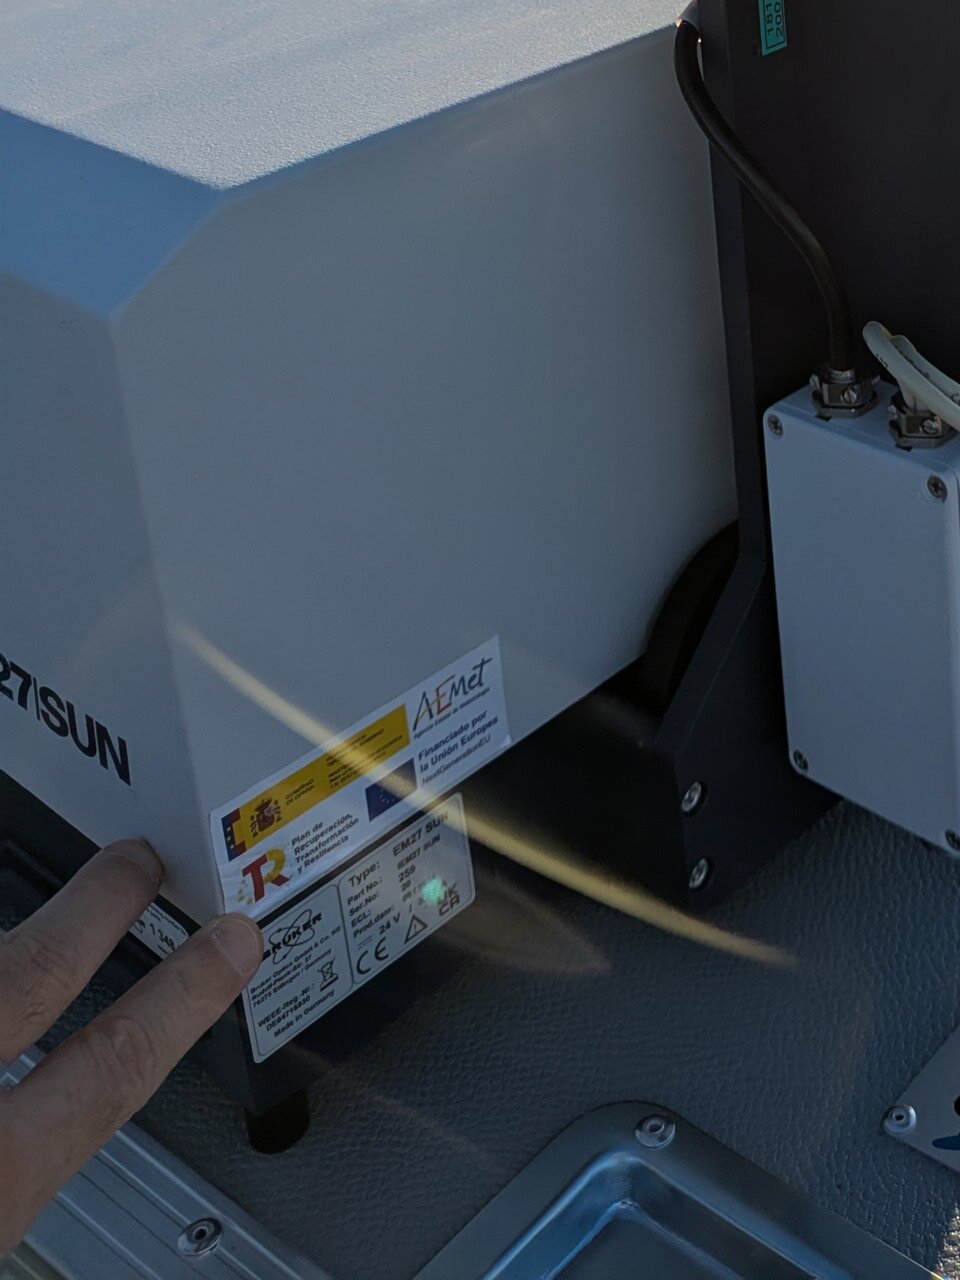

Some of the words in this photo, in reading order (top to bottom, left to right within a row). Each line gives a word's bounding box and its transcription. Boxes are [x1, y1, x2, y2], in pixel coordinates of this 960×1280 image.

[418, 722, 470, 761] Financiado
[471, 710, 487, 728] por
[420, 763, 429, 774] la
[431, 741, 459, 765] Unión
[461, 716, 498, 746] Europea
[291, 829, 311, 846] Plan
[312, 821, 324, 833] de
[293, 813, 353, 856] Recuperación,
[295, 817, 360, 863] Transformación
[304, 835, 349, 869] Resiliencia
[347, 860, 380, 888] Type:
[392, 828, 422, 857] EM27
[347, 886, 366, 906] Part
[378, 920, 391, 935] 24
[273, 1020, 294, 1038] Made
[303, 989, 335, 1016] Germany
